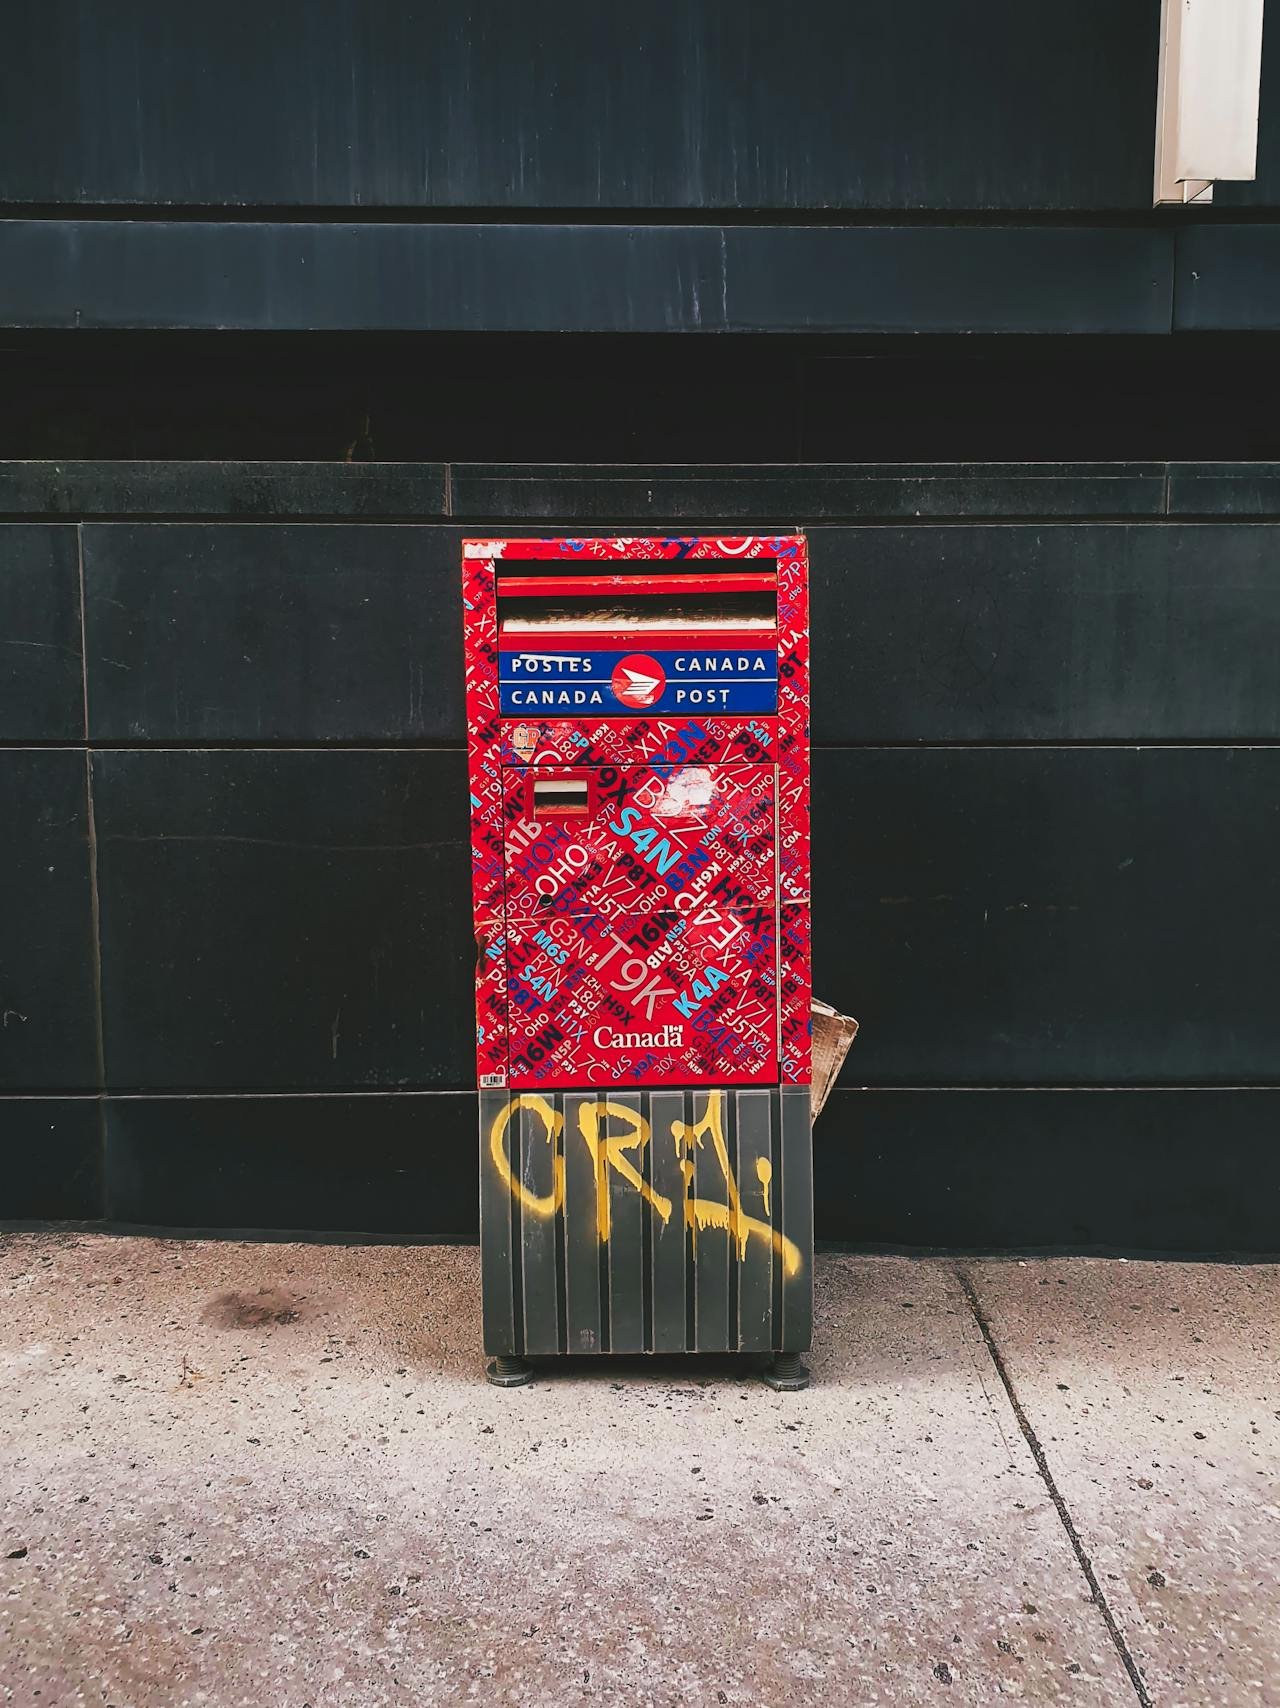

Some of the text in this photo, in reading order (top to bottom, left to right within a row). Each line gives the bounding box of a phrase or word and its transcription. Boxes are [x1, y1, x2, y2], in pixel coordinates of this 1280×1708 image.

[512, 658, 765, 672] POSTES CANADA
[511, 690, 730, 704] CANADA POST
[781, 686, 801, 704] P3Y
[589, 723, 610, 744] K6H
[603, 730, 633, 760] B2Z
[633, 721, 677, 759] X1A
[648, 720, 707, 779] B3N
[745, 720, 774, 748] S4N
[574, 745, 639, 807] H9X
[720, 742, 762, 788] V7J
[596, 802, 616, 826] S7P
[632, 775, 709, 850] B2Z
[751, 813, 773, 836] B2J
[580, 821, 618, 859] X1A
[608, 807, 684, 876] S4N
[723, 812, 756, 848] T9K
[708, 840, 735, 865] P8T
[727, 854, 746, 874] K6H
[755, 848, 775, 869] P3Y
[616, 853, 657, 890] P8T
[664, 847, 709, 892] B3N
[691, 861, 723, 893] K6H
[740, 860, 769, 889] B2Z
[579, 884, 602, 904] Y1A
[602, 864, 645, 909] V7J
[591, 893, 628, 921] J5T
[674, 890, 744, 950] E4P
[711, 875, 773, 935] H9X
[549, 918, 594, 960] G3N
[627, 904, 680, 951] M9L
[665, 918, 687, 943] N5P
[532, 929, 571, 965] M6S
[646, 940, 674, 969] A1B
[530, 952, 569, 989] R7N
[594, 931, 678, 1022] T9K
[668, 951, 697, 982] P9A
[715, 946, 753, 987] X1A
[518, 964, 560, 1003] S4N
[571, 985, 601, 1011] P8T
[672, 965, 732, 1020] K4A
[567, 999, 591, 1019] P3Y
[602, 994, 636, 1027] H9X
[709, 986, 738, 1014] E3N
[715, 1007, 736, 1025] Y1A
[736, 989, 774, 1029] V7J
[553, 1008, 589, 1044] H1X
[691, 1009, 741, 1057] B4E
[726, 1014, 759, 1040] J5T
[512, 1023, 565, 1071] M9L
[551, 1039, 573, 1064] N5P
[747, 1035, 772, 1061] T9K
[560, 1059, 578, 1076] P3Y
[567, 1044, 608, 1083] L7C
[611, 1054, 633, 1079] S7P
[715, 1057, 738, 1077] H1T
